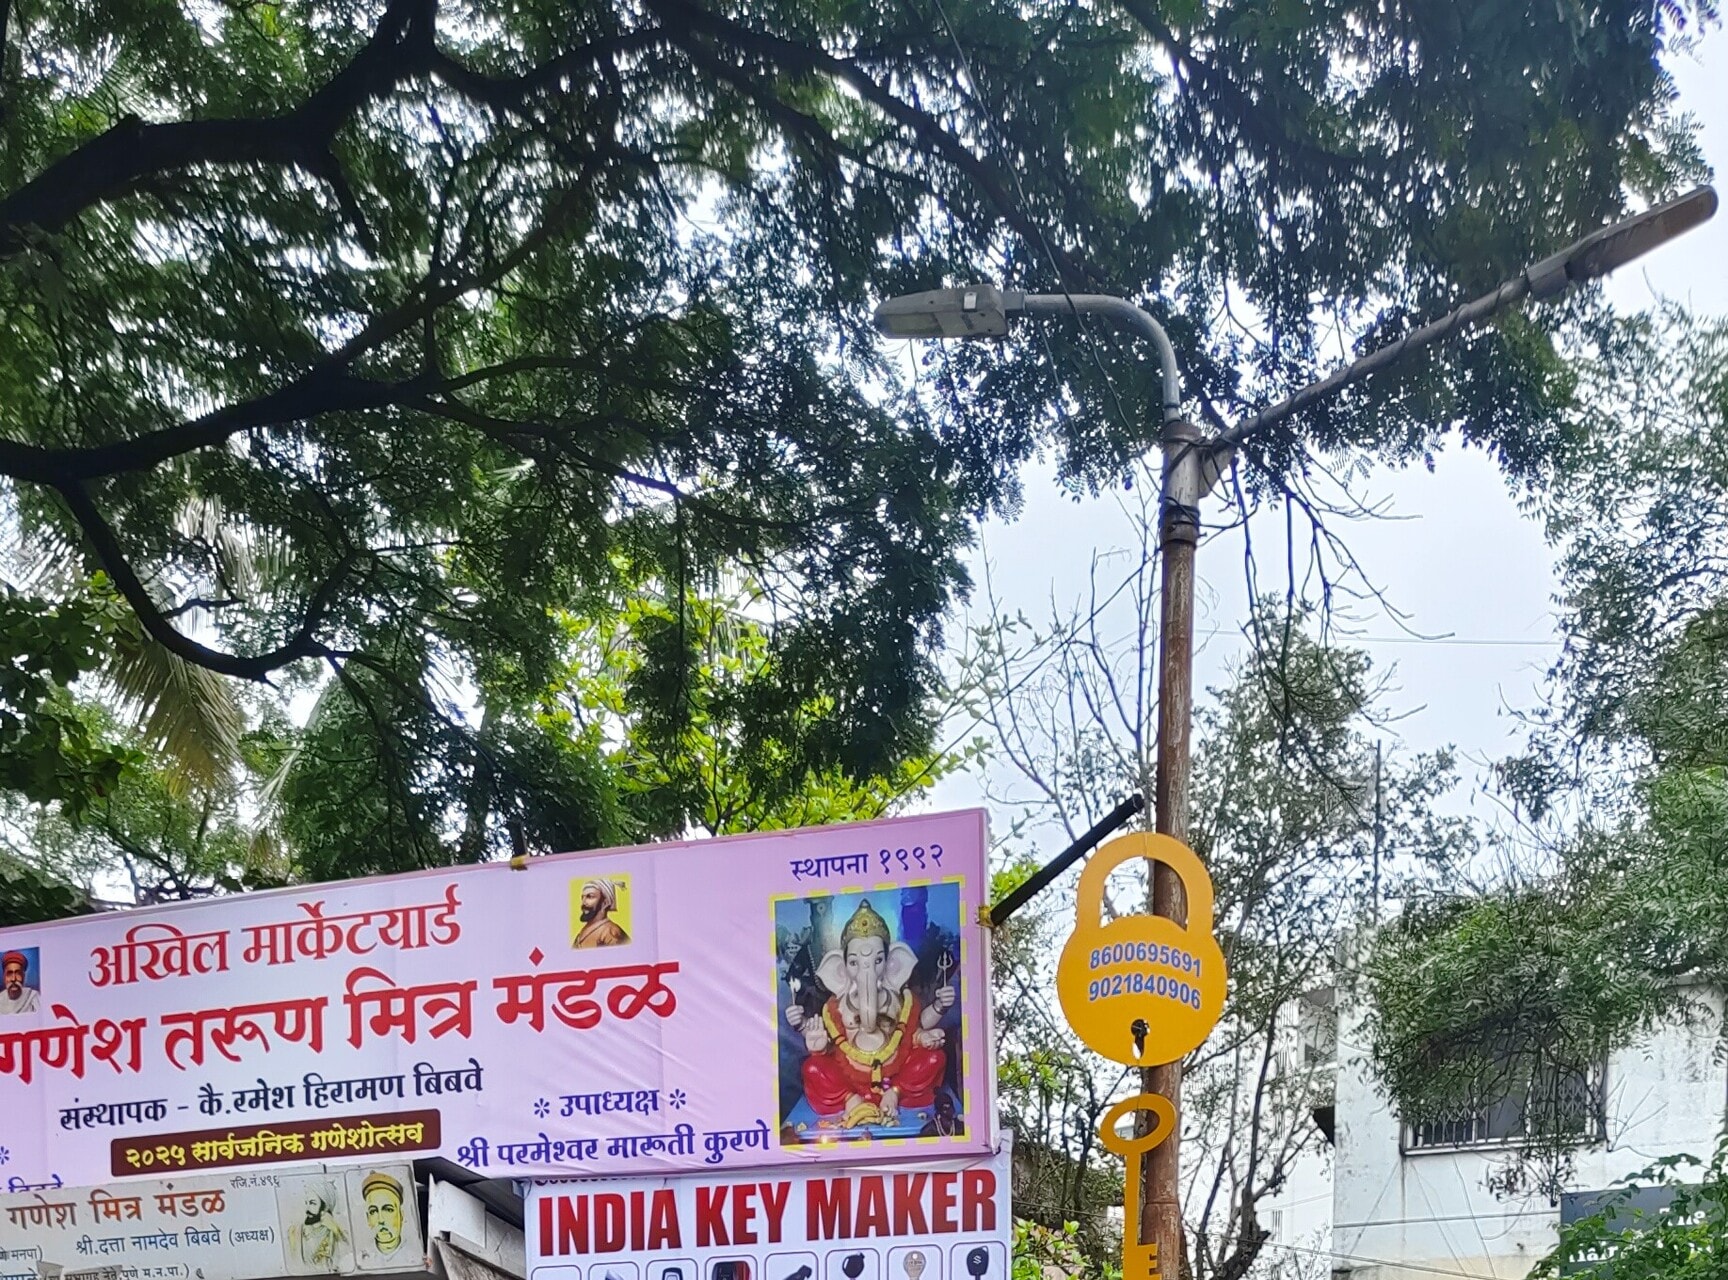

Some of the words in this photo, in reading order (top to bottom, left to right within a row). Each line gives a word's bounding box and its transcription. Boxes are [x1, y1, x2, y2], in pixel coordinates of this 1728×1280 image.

[790, 852, 868, 882] स्थापना
[879, 843, 944, 873] १९९२
[88, 923, 229, 988] अखिल
[243, 884, 462, 966] मार्केटयार्ड
[1089, 942, 1202, 978] 8600695691
[0, 1004, 147, 1085] गणेश
[161, 995, 329, 1071] तरूण
[343, 966, 478, 1050] मित्र
[493, 946, 680, 1033] मंडळ
[1089, 973, 1201, 1010] 9021840906
[59, 1096, 168, 1131] संस्थापक
[302, 1072, 405, 1109] हिरामण
[413, 1057, 484, 1093] बिबवे
[558, 1087, 660, 1118] उपाध्यक्ष
[125, 1144, 186, 1171] २०२५
[191, 1130, 304, 1164] सार्वजनिक
[310, 1120, 425, 1151] गणेशोत्सव
[456, 1136, 488, 1169] श्री
[496, 1128, 600, 1167] परमेश्वर
[606, 1123, 696, 1158] मारूती
[703, 1118, 771, 1164] कुरणे
[5, 1193, 78, 1231] गणेश
[87, 1188, 143, 1225] मित्र
[153, 1181, 226, 1218] मंडळ
[538, 1187, 683, 1258] INDIA
[695, 1180, 792, 1248] KEY
[805, 1168, 998, 1242] MAKER
[130, 1228, 179, 1251] नामदेव
[184, 1223, 222, 1248] बिबवे
[228, 1226, 275, 1248] (अध्यक्ष)
